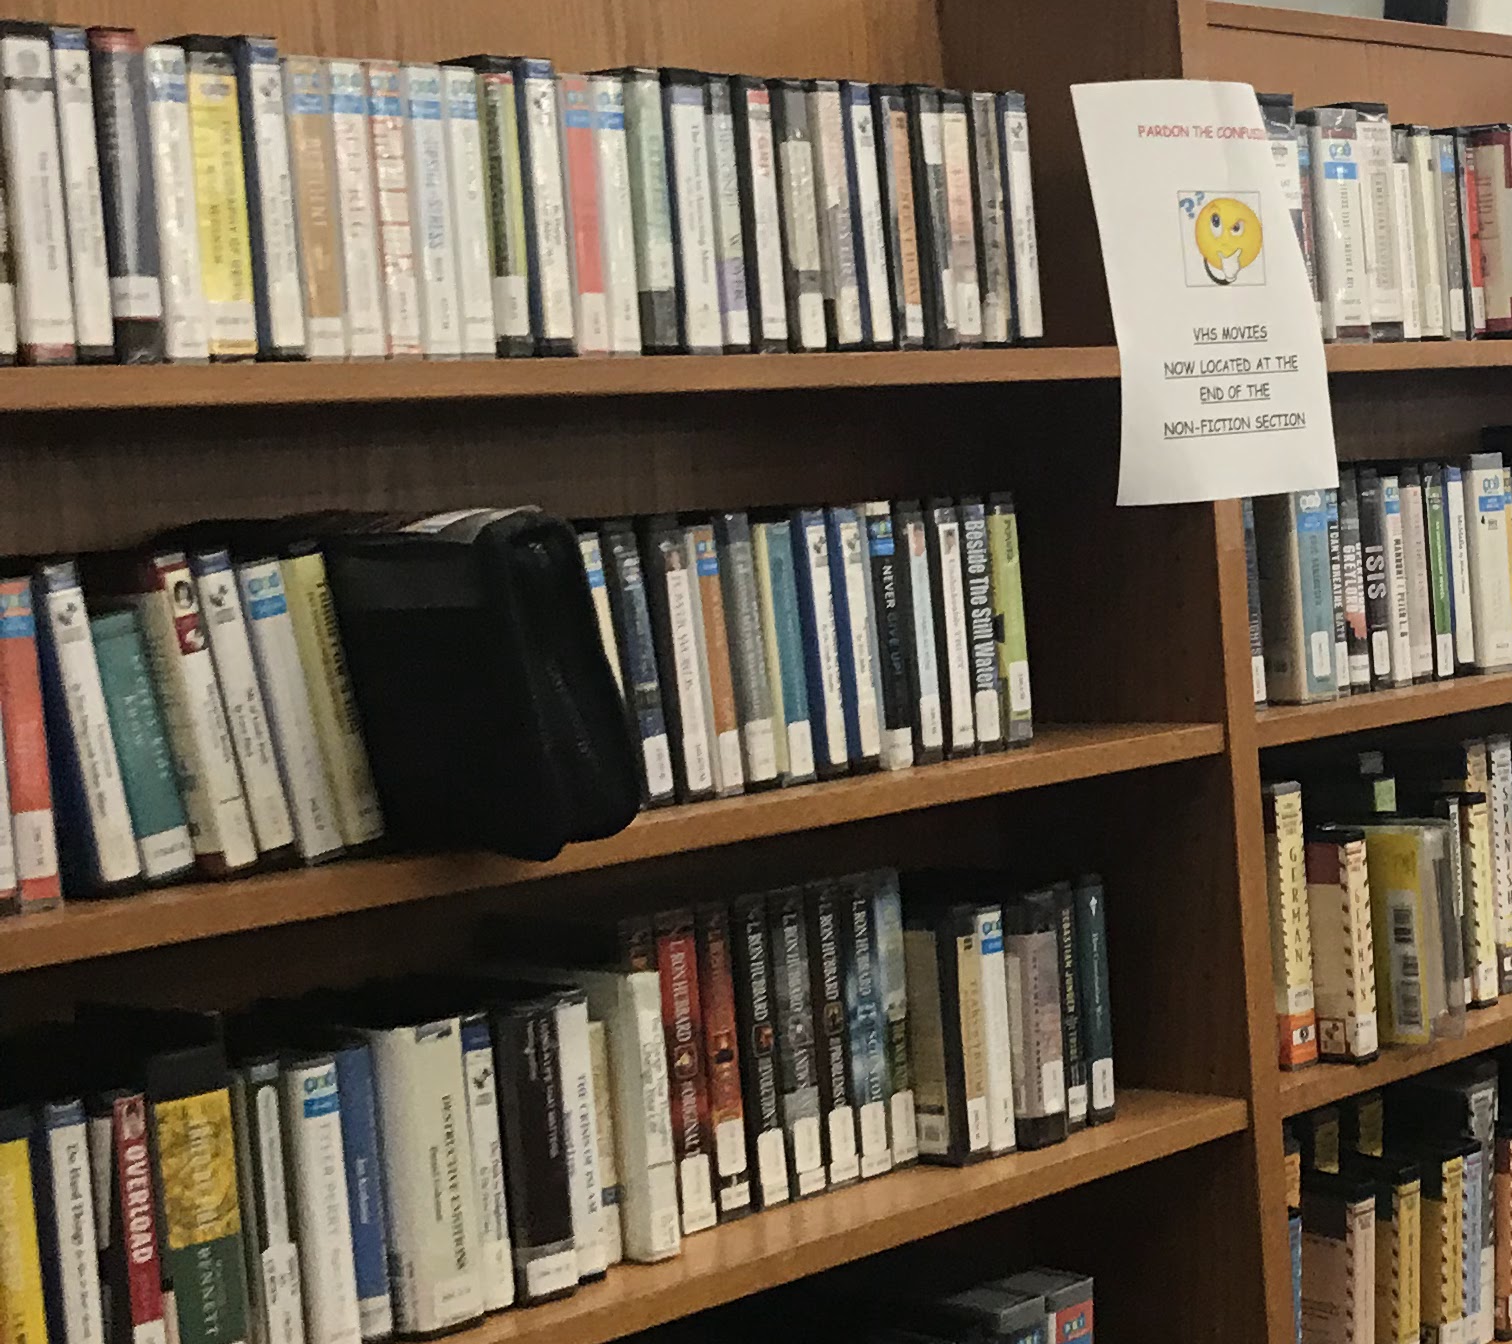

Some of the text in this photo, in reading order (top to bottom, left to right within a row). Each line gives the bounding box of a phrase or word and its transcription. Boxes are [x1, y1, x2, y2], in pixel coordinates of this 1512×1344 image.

[1137, 124, 1266, 141] PARDON THE CONFUS
[1193, 325, 1268, 342] VHS MOVIES
[1164, 354, 1298, 376] NOW LOCATED AT THE
[1200, 382, 1271, 402] END OF THE
[1164, 412, 1306, 437] NON-FICTION SECTION
[965, 520, 987, 574] Beside
[1330, 532, 1340, 560] CAN'T
[882, 565, 896, 609] NEVER
[1332, 564, 1343, 608] BREATHE
[1343, 545, 1358, 612] GREYLORD
[1365, 545, 1387, 599] ISIS
[969, 576, 990, 605] The
[971, 607, 995, 640] Still
[1289, 845, 1304, 963] GERMAN
[125, 1145, 154, 1264] OVERLOAD
